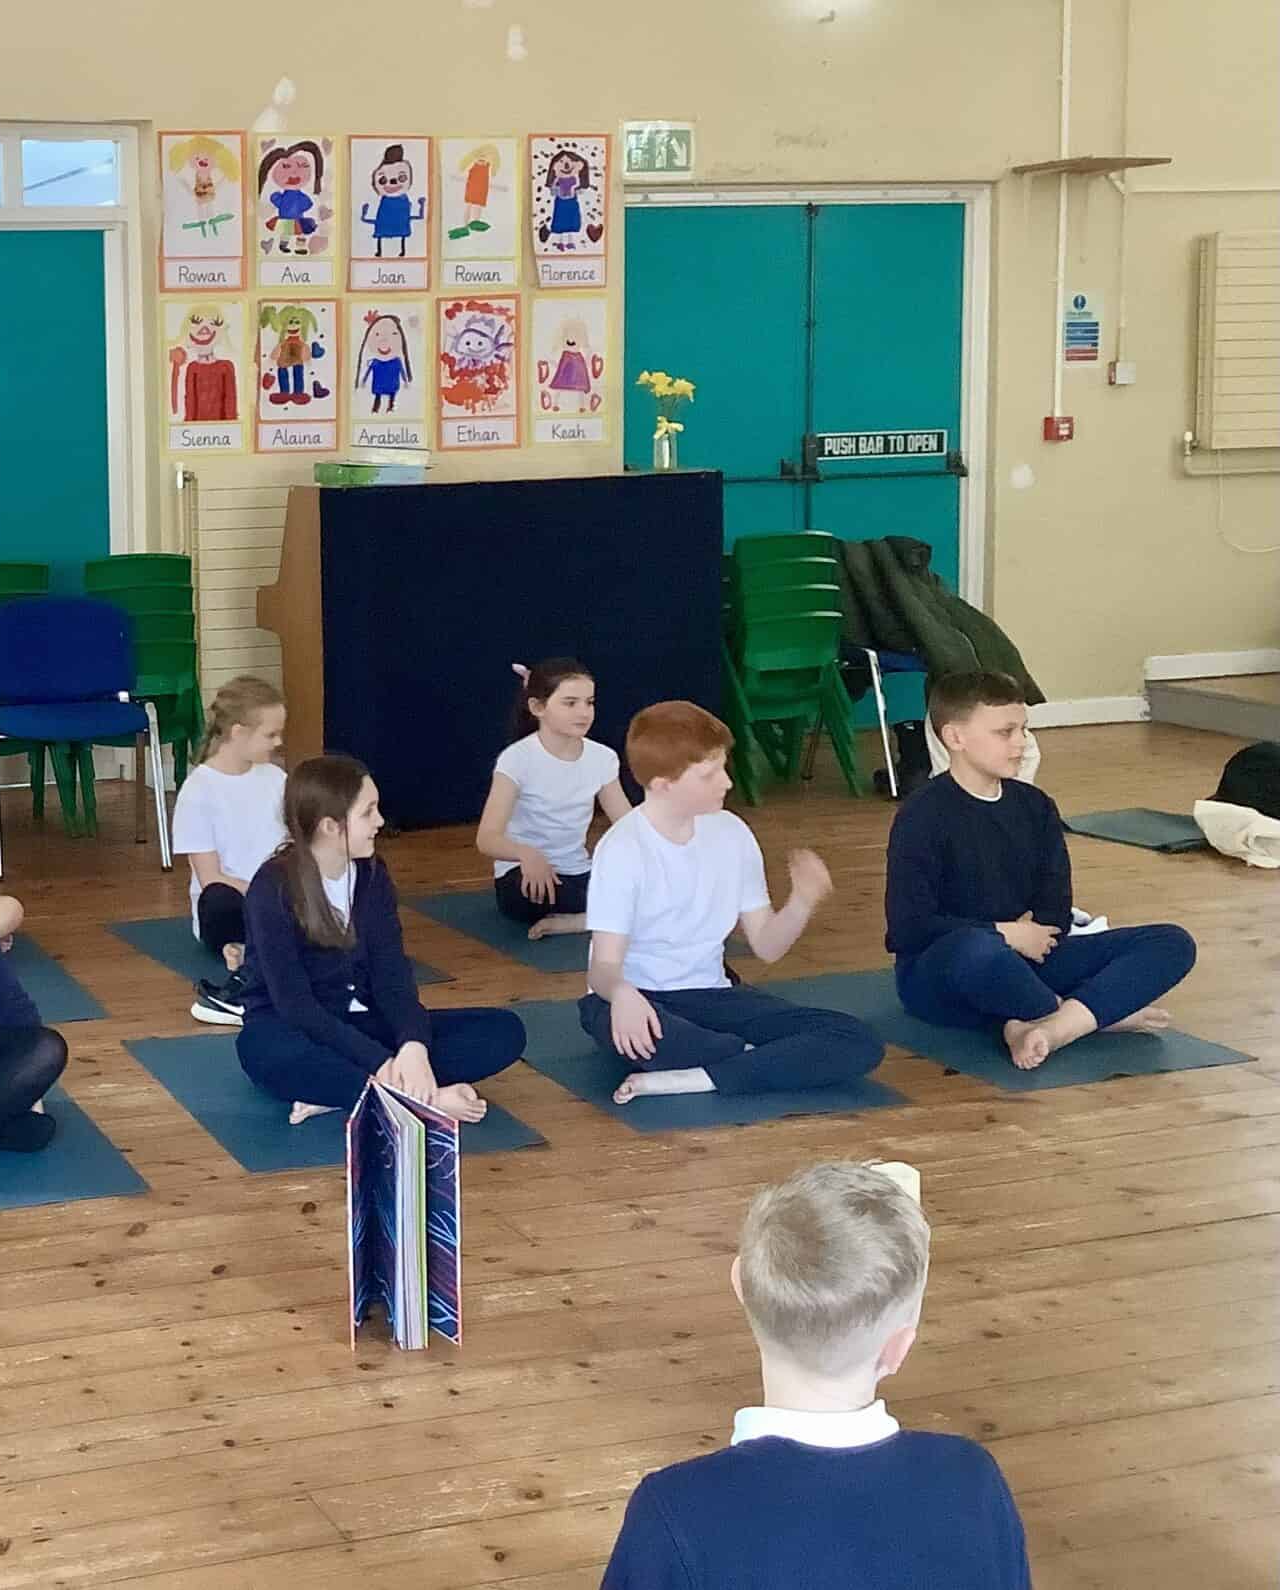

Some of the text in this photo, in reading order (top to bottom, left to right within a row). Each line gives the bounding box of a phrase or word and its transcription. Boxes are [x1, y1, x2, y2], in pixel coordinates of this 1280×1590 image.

[179, 266, 226, 282] Rowan
[282, 267, 310, 282] Ava
[372, 268, 405, 284] Joan
[456, 265, 500, 281] Rowan
[542, 264, 594, 280] Florence
[182, 430, 231, 446] Sienna
[273, 429, 322, 446] Alaina
[359, 428, 419, 444] Arabella
[457, 426, 500, 443] Ethan
[552, 424, 585, 439] Keah
[824, 434, 938, 455] PUSH BAR TO OPEN
